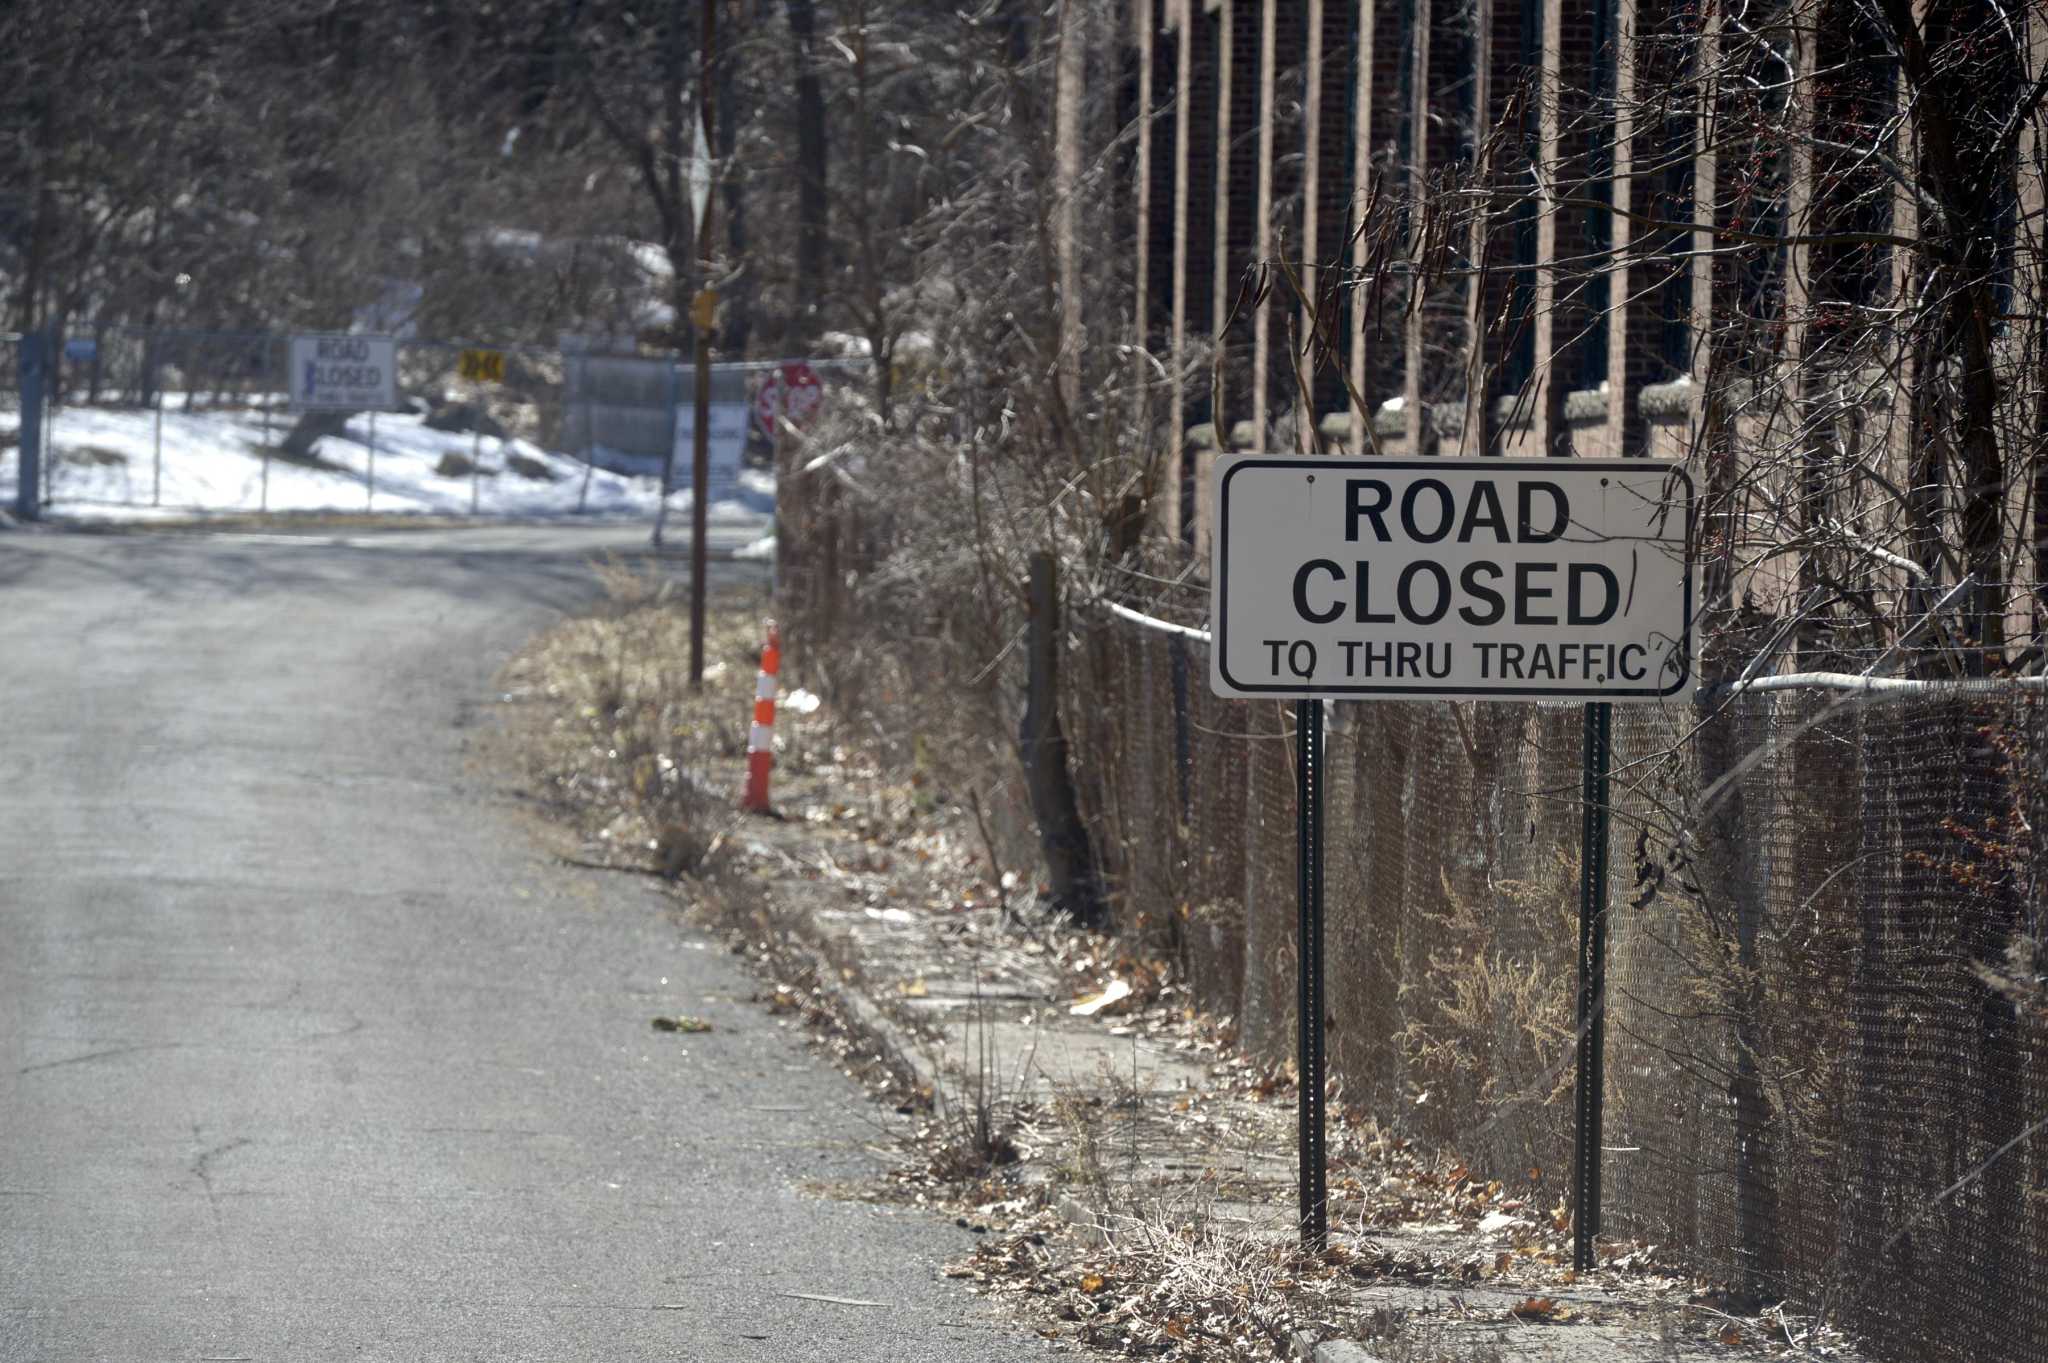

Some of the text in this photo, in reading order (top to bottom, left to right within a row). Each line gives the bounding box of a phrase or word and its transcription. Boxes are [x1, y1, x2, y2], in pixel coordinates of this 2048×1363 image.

[318, 338, 371, 361] ROAD
[761, 385, 819, 418] SOP
[1344, 478, 1571, 545] ROAD
[1292, 558, 1620, 626] CLOSED
[1263, 639, 1648, 681] TO THRU TRAFFIC
